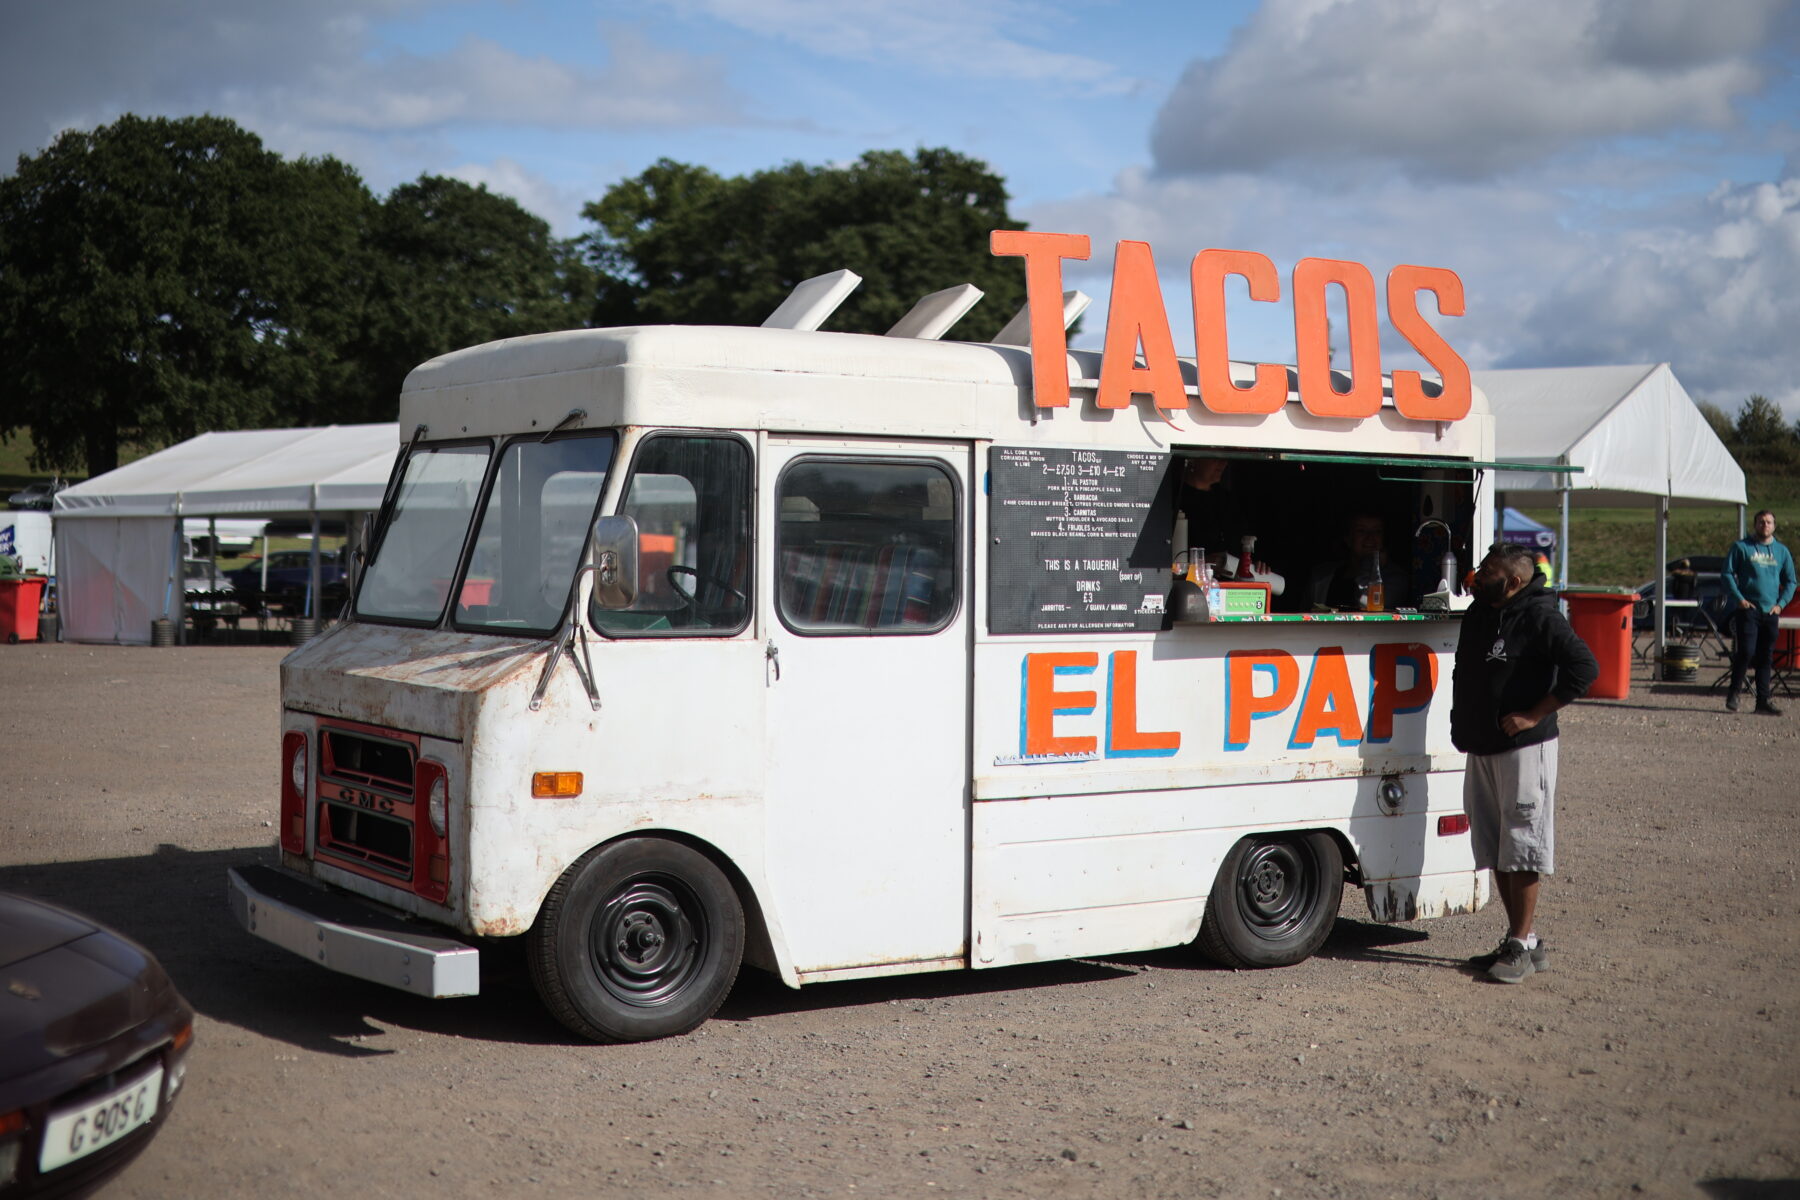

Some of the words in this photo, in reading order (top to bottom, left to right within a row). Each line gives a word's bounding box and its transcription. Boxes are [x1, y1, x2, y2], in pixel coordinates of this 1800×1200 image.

[989, 229, 1472, 421] TACOS
[1072, 451, 1096, 463] TACOS
[1045, 560, 1060, 570] THIS
[1064, 560, 1070, 570] IS
[1075, 560, 1079, 570] A
[1083, 558, 1119, 571] TAQUERIA!
[1119, 570, 1133, 583] (SORT
[1134, 572, 1142, 584] OF)
[1076, 581, 1100, 591] DRINKS
[1083, 592, 1093, 603] £3
[1019, 650, 1181, 759] EL
[1223, 642, 1438, 752] PAP
[339, 786, 395, 814] GMC
